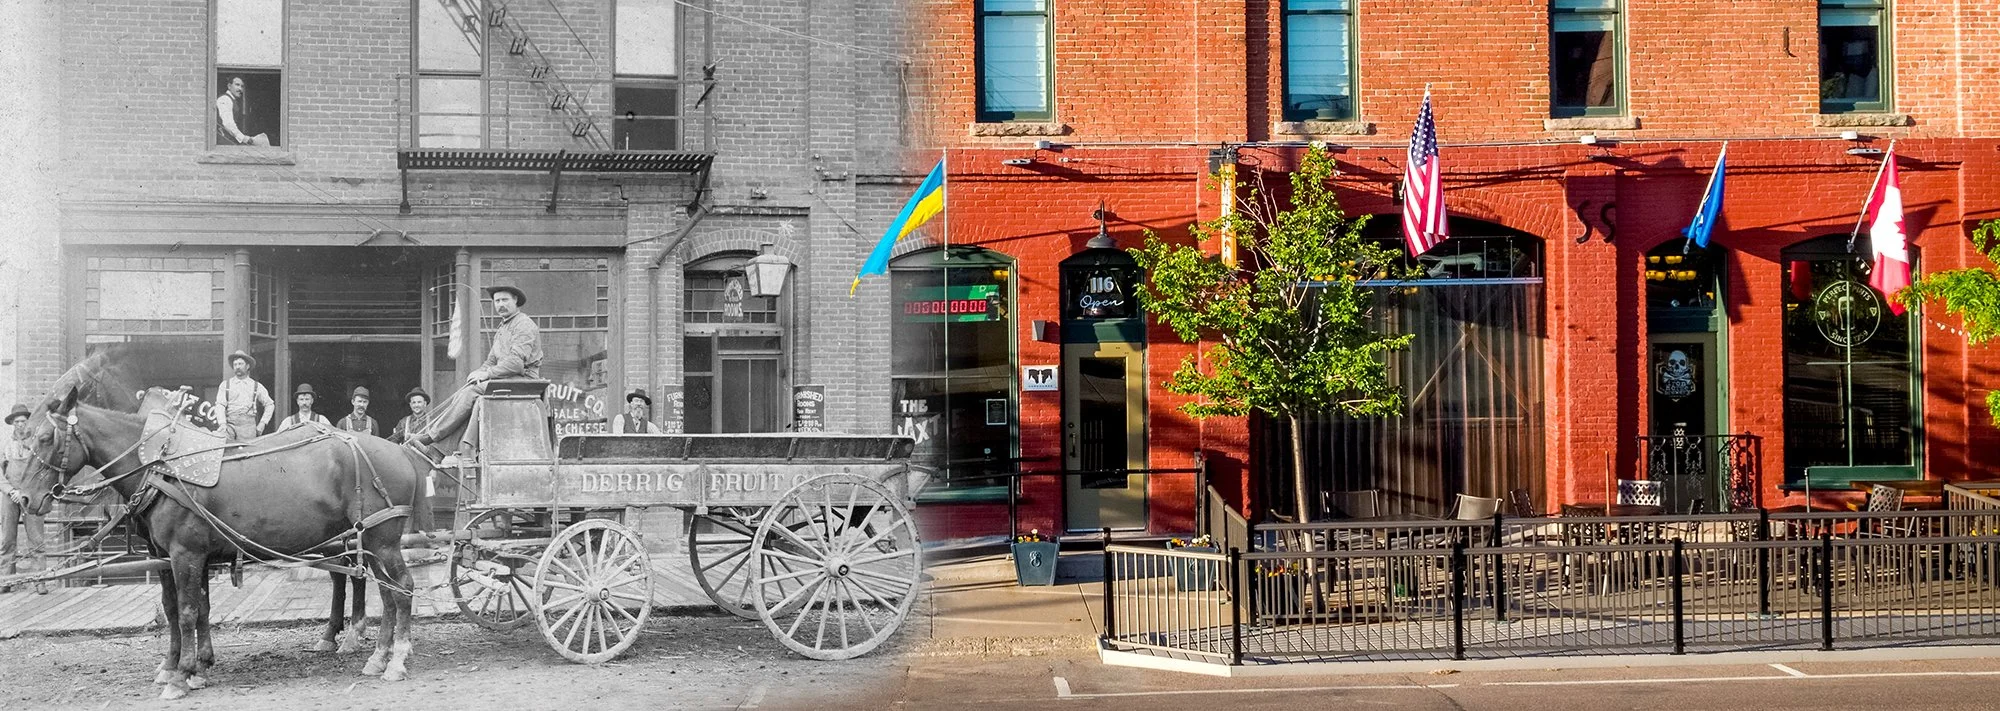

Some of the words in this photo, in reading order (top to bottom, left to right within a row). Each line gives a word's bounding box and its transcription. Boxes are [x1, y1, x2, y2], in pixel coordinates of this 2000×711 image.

[1090, 276, 1114, 293] 116
[1822, 284, 1852, 304] PERFEC
[1080, 295, 1124, 309] Open
[1830, 331, 1852, 344] SINC
[900, 399, 929, 413] THE
[565, 422, 608, 435] CHEESE
[581, 473, 685, 493] DERRIG
[710, 472, 785, 492] FRUIT
